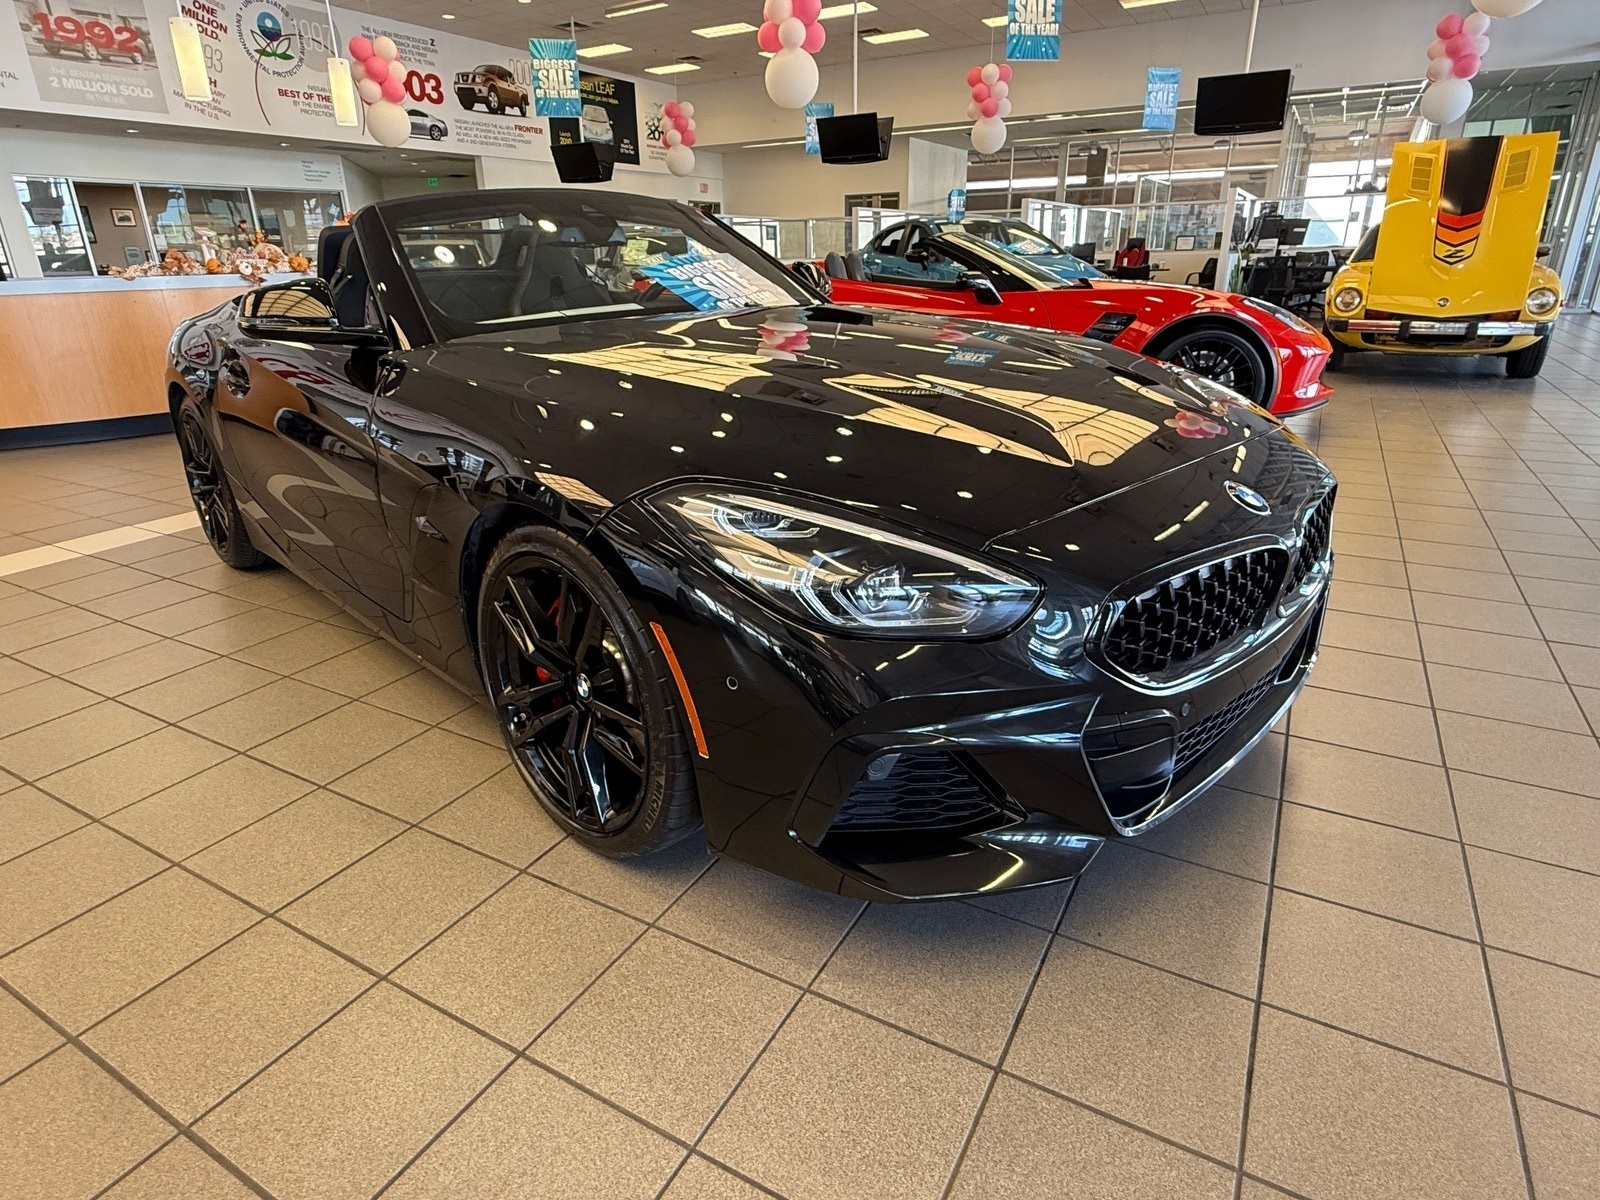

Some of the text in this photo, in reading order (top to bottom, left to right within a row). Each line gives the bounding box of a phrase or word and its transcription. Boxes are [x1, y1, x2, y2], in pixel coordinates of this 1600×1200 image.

[193, 0, 218, 19] ONE
[1015, 0, 1056, 24] SALE
[181, 5, 228, 34] MILLION
[1009, 22, 1059, 36] OF THE YEAR!
[33, 11, 143, 53] 1992
[197, 23, 221, 42] OLD.
[429, 38, 436, 47] Z
[204, 44, 223, 73] 93
[532, 58, 577, 70] BIGGEST
[50, 77, 153, 98] 2 MILLION SOLD
[405, 70, 444, 105] 03
[538, 69, 575, 90] SALE
[595, 81, 615, 96] LEAF
[1147, 83, 1179, 93] BIGGEST
[277, 88, 333, 104] BEST OF THE
[535, 89, 546, 98] OF
[546, 89, 559, 98] THE
[559, 89, 579, 99] YEAR!
[1149, 90, 1175, 108] SALE
[301, 100, 312, 109] THE
[313, 102, 334, 111] ENVIRO
[514, 124, 544, 135] FRONTIER
[664, 258, 735, 280] BIGGEST
[692, 270, 760, 300] SALE
